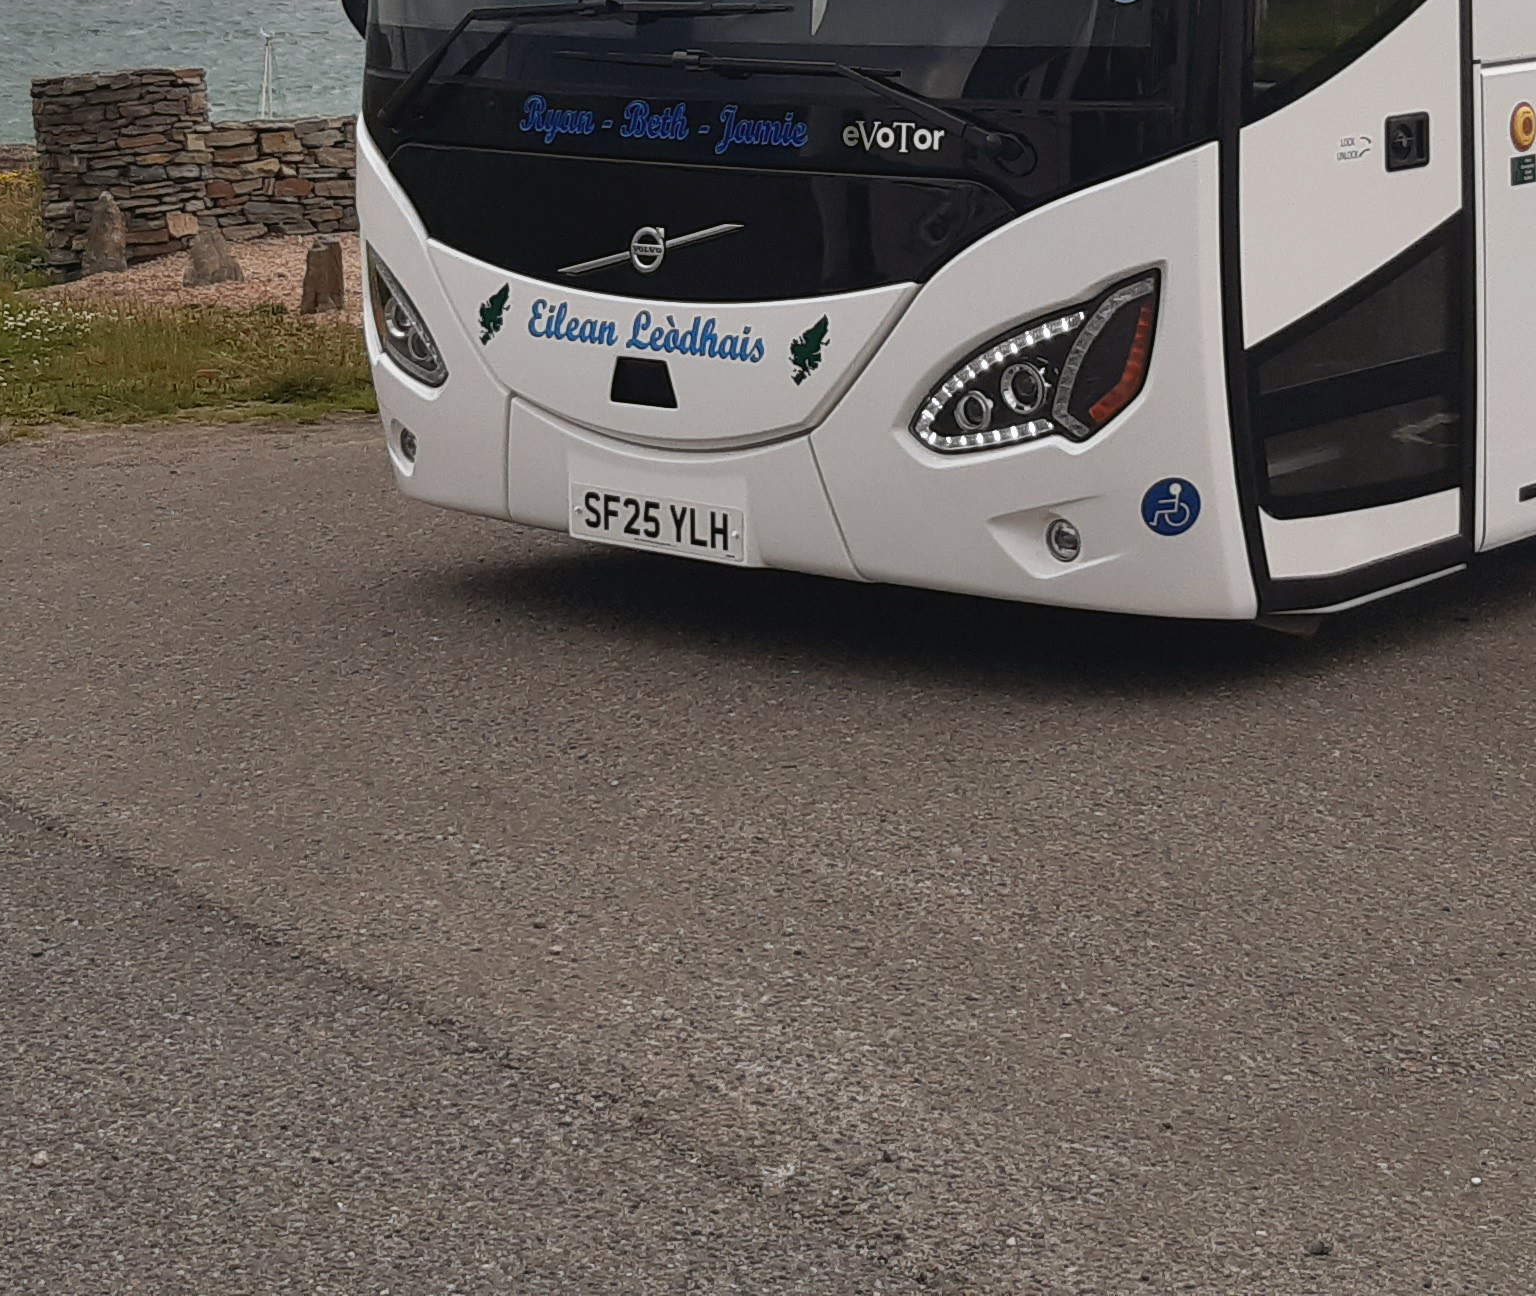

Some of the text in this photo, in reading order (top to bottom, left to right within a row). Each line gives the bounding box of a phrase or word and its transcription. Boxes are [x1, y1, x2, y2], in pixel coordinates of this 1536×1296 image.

[519, 94, 596, 145] Ryan
[619, 99, 690, 141] Beth
[714, 104, 809, 154] Jamie
[842, 120, 946, 153] eVoTor
[1340, 137, 1356, 147] LOCK
[632, 245, 663, 254] VOLVO
[527, 298, 766, 364] Eilean Leòdhais
[584, 491, 729, 551] SF25 YLH
